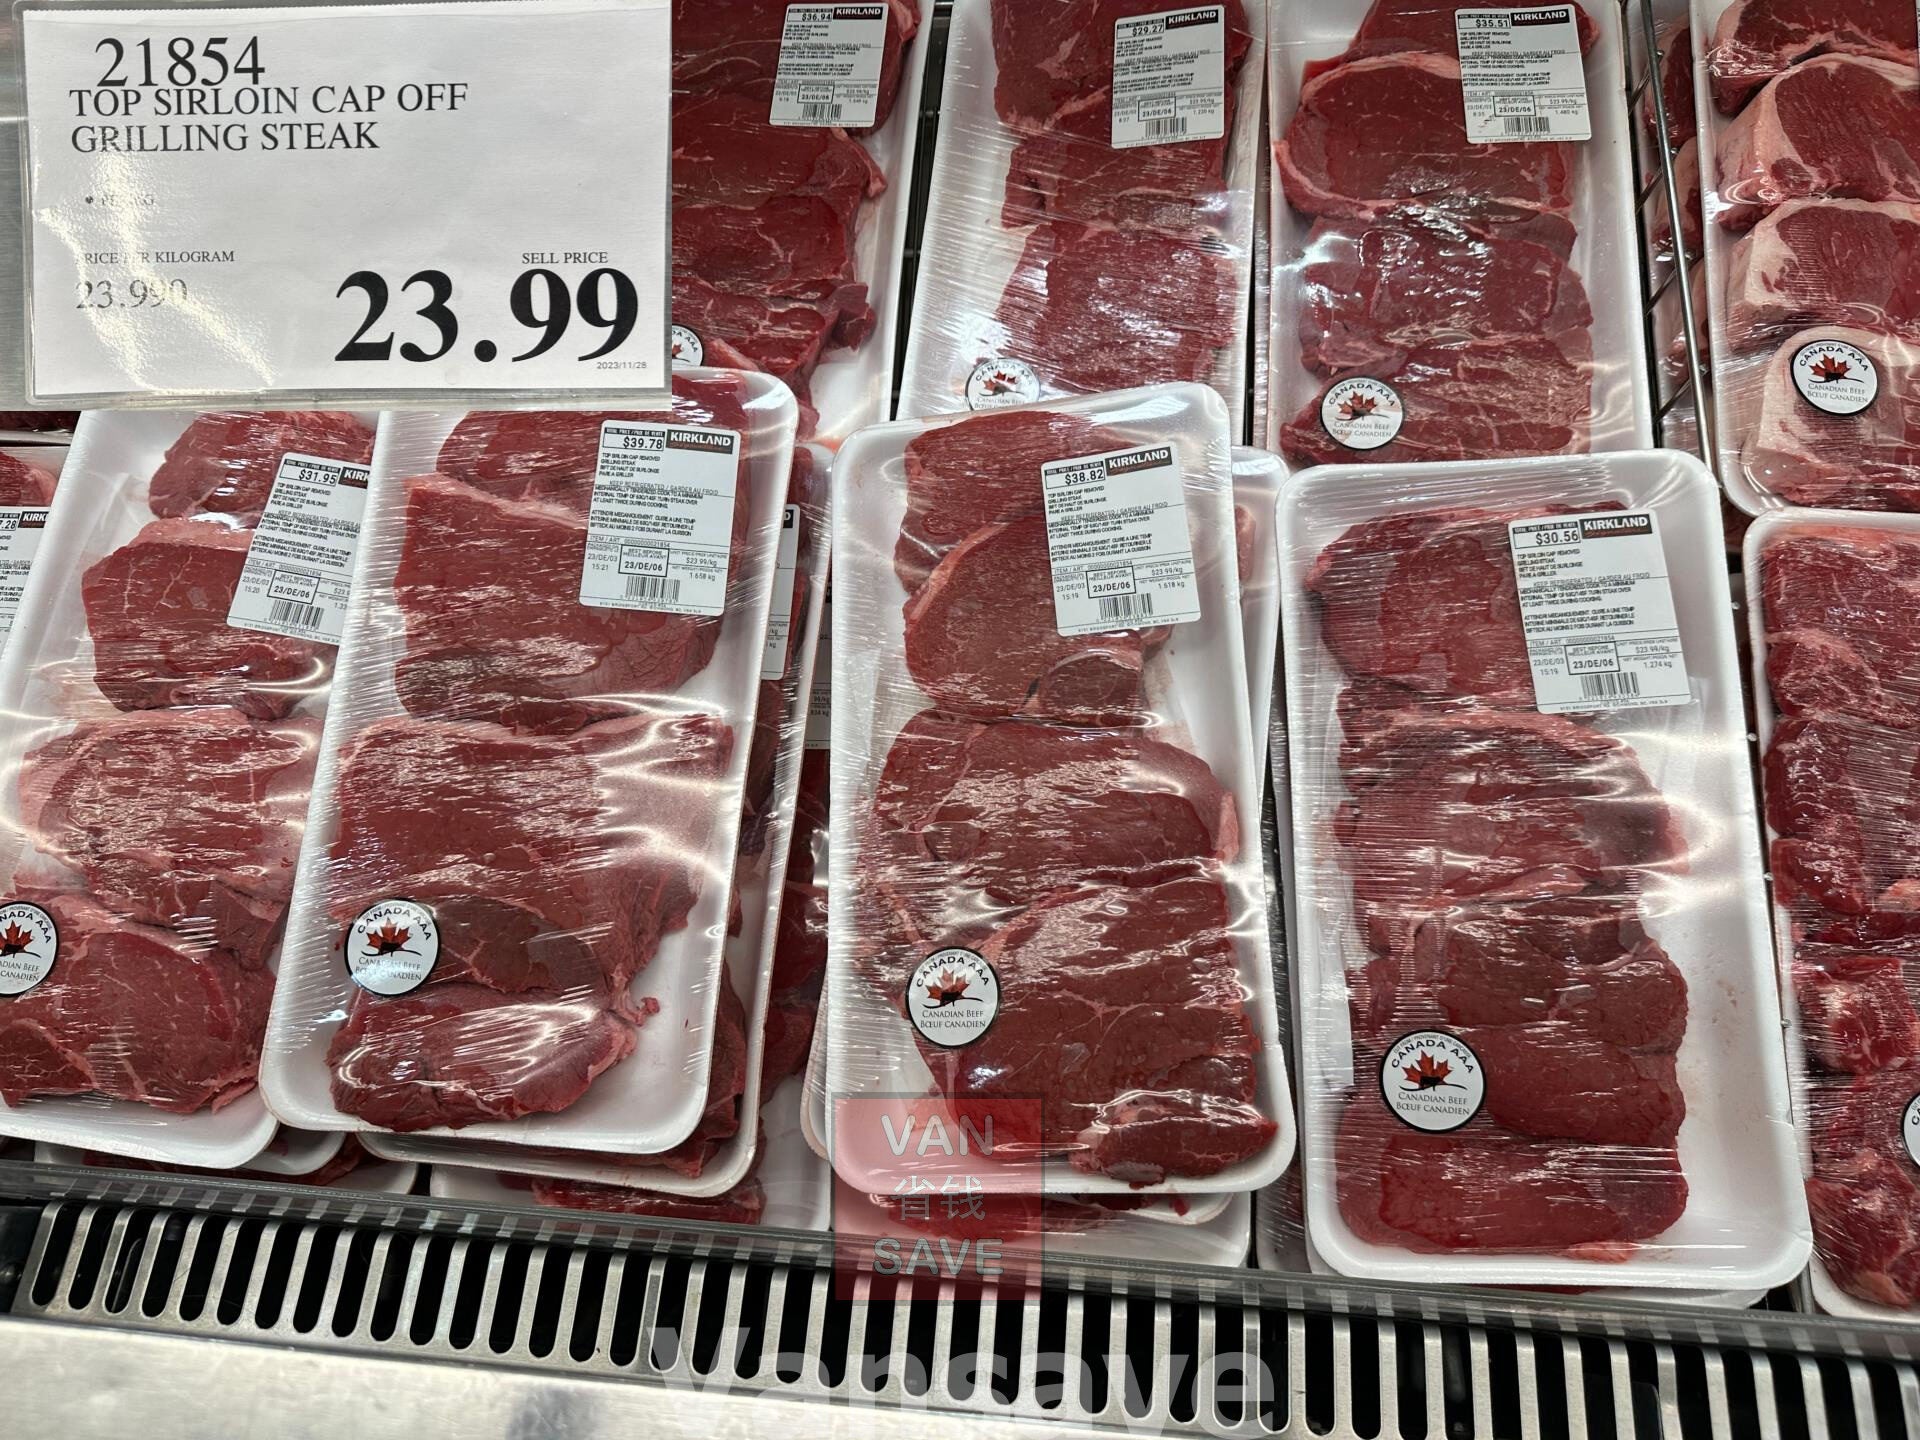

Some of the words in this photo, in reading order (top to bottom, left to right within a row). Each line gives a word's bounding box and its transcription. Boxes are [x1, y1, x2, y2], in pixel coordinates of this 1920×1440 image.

[802, 13, 831, 22] $36.94
[836, 7, 881, 15] KIRKLAND
[1475, 19, 1508, 29] $35.51
[1513, 10, 1567, 21] KIRKLAND
[1132, 24, 1163, 37] $29.27
[1168, 11, 1217, 25] KIRKLAND
[94, 36, 266, 88] 21854
[70, 88, 141, 117] TOP
[154, 87, 299, 116] SIRLOIN
[312, 85, 385, 113] CAP
[397, 83, 468, 111] OFF
[71, 123, 248, 153] GRILLING
[261, 121, 380, 150] STEAK
[76, 252, 118, 264] RICE
[155, 251, 235, 262] KILOGRAM
[521, 252, 560, 265] SELL
[564, 252, 608, 264] PRICE
[76, 279, 188, 309] 23.990
[334, 268, 639, 364] 23.99
[1799, 346, 1844, 366] CANADA
[1848, 352, 1869, 371] AAA
[596, 361, 648, 371] 2023/11/28
[1328, 383, 1373, 405] CANADA
[1376, 388, 1395, 406] AAA
[1808, 383, 1847, 393] CANADIAN
[1829, 393, 1868, 402] CANADIEN
[1334, 422, 1372, 430] CANADIAN
[623, 436, 662, 451] $39.78
[670, 431, 731, 446] KIRKLAND
[1064, 467, 1103, 485] $38.82
[1108, 448, 1169, 468] KIRKLAND
[298, 468, 337, 485] $31.95
[343, 469, 369, 481] KIRK
[23, 512, 48, 522] KIRK
[1534, 529, 1579, 545] $30.56
[1583, 515, 1648, 531] KIRKLAND
[587, 553, 617, 561] 23/DE/03
[624, 560, 662, 571] 23/DE/06
[1092, 580, 1130, 593] 23/DE/06
[1176, 580, 1184, 588] kg
[273, 585, 310, 598] 23/DE/06
[1572, 658, 1614, 669] 23/DE/06
[0, 911, 33, 922] NADA
[35, 920, 51, 944] AAA
[357, 907, 411, 934] CANADA
[414, 916, 432, 941] AAA
[0, 961, 21, 970] ADIAN
[23, 963, 40, 972] BEEF
[916, 956, 965, 988] CANADA
[968, 962, 989, 986] AAA
[0, 970, 40, 982] CANADIEN
[922, 1009, 964, 1018] CANADIAN
[966, 1009, 984, 1018] BEEF
[944, 1020, 986, 1028] CANADIEN
[1391, 1039, 1446, 1068] CANADA
[1450, 1048, 1474, 1073] AAA
[1398, 1091, 1446, 1103] CANADIAN
[1448, 1095, 1468, 1105] BEEF
[1423, 1104, 1470, 1115] CANADIEN
